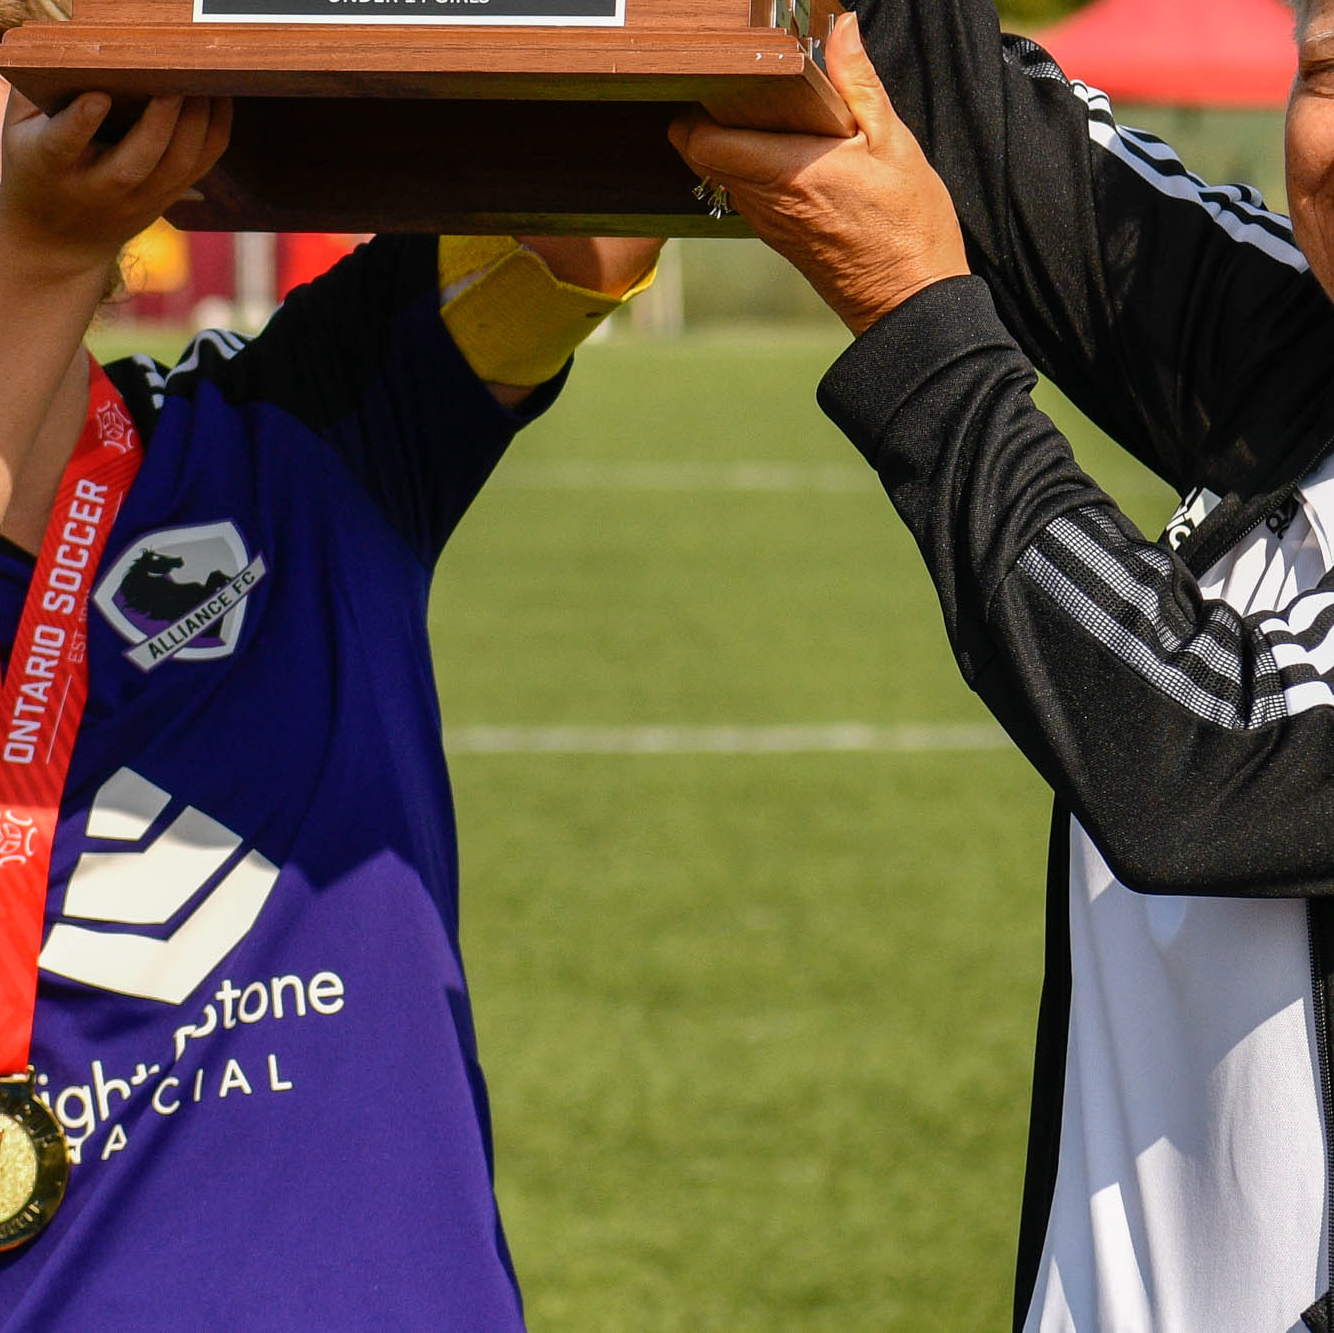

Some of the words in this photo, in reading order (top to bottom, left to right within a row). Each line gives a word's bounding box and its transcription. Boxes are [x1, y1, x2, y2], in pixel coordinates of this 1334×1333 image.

[2, 623, 66, 765] ONTARIO
[42, 478, 109, 616] SOCCER
[147, 592, 233, 660] ALLIANCE
[231, 570, 256, 595] FC
